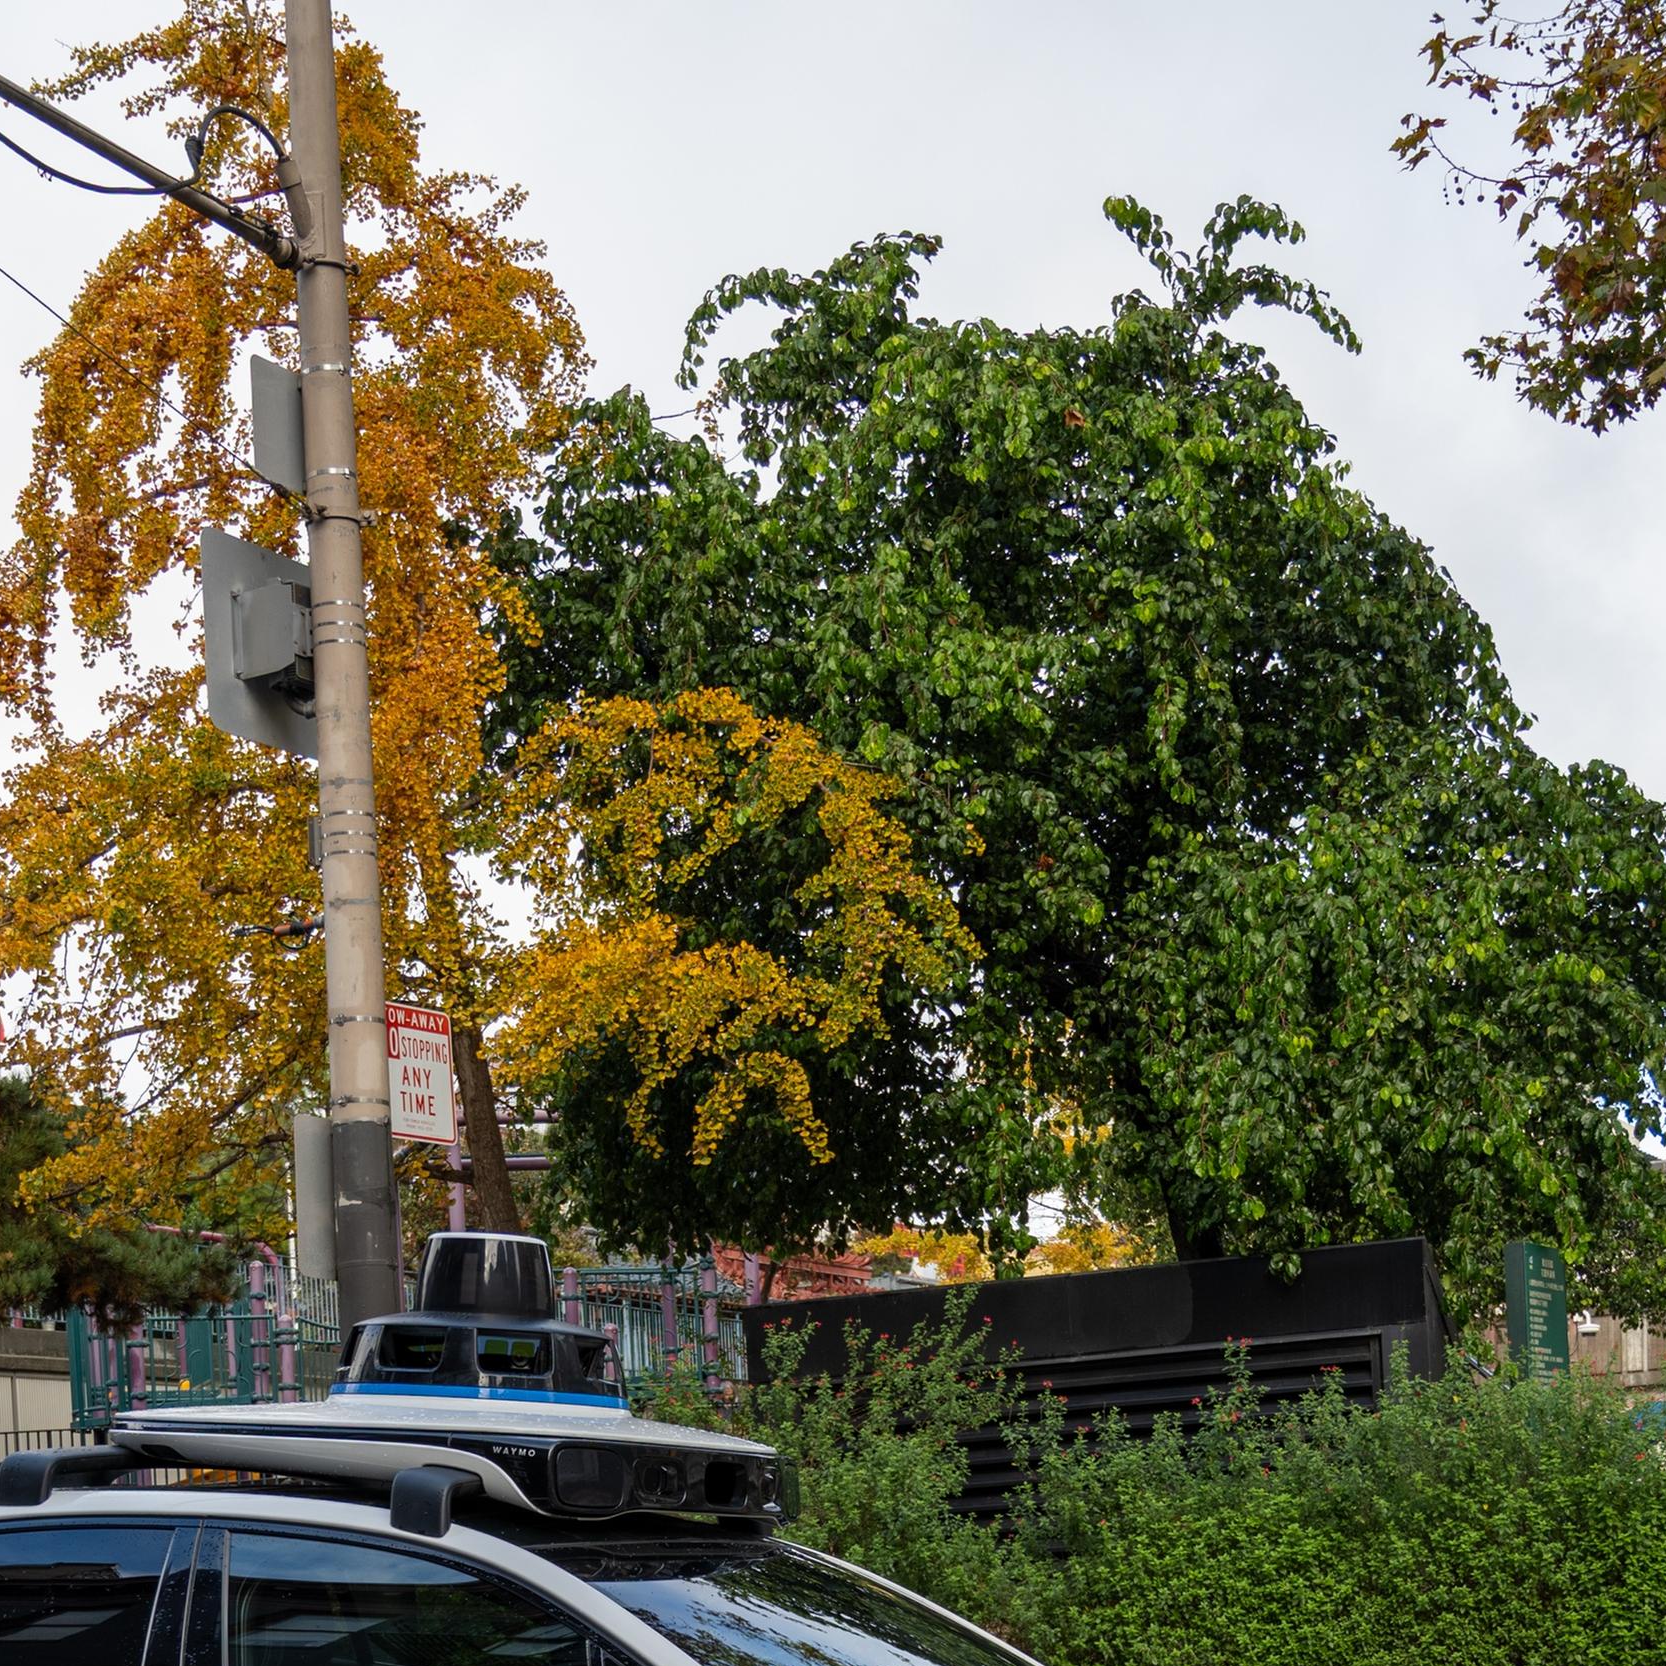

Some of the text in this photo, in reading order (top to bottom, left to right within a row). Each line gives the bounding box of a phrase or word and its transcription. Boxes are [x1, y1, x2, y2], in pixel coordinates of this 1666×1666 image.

[386, 1008, 446, 1032] OW-AWAY
[401, 1036, 448, 1065] STOPPING
[402, 1065, 432, 1090] ANY
[400, 1091, 436, 1117] TIME
[492, 1446, 536, 1457] WAYMO
